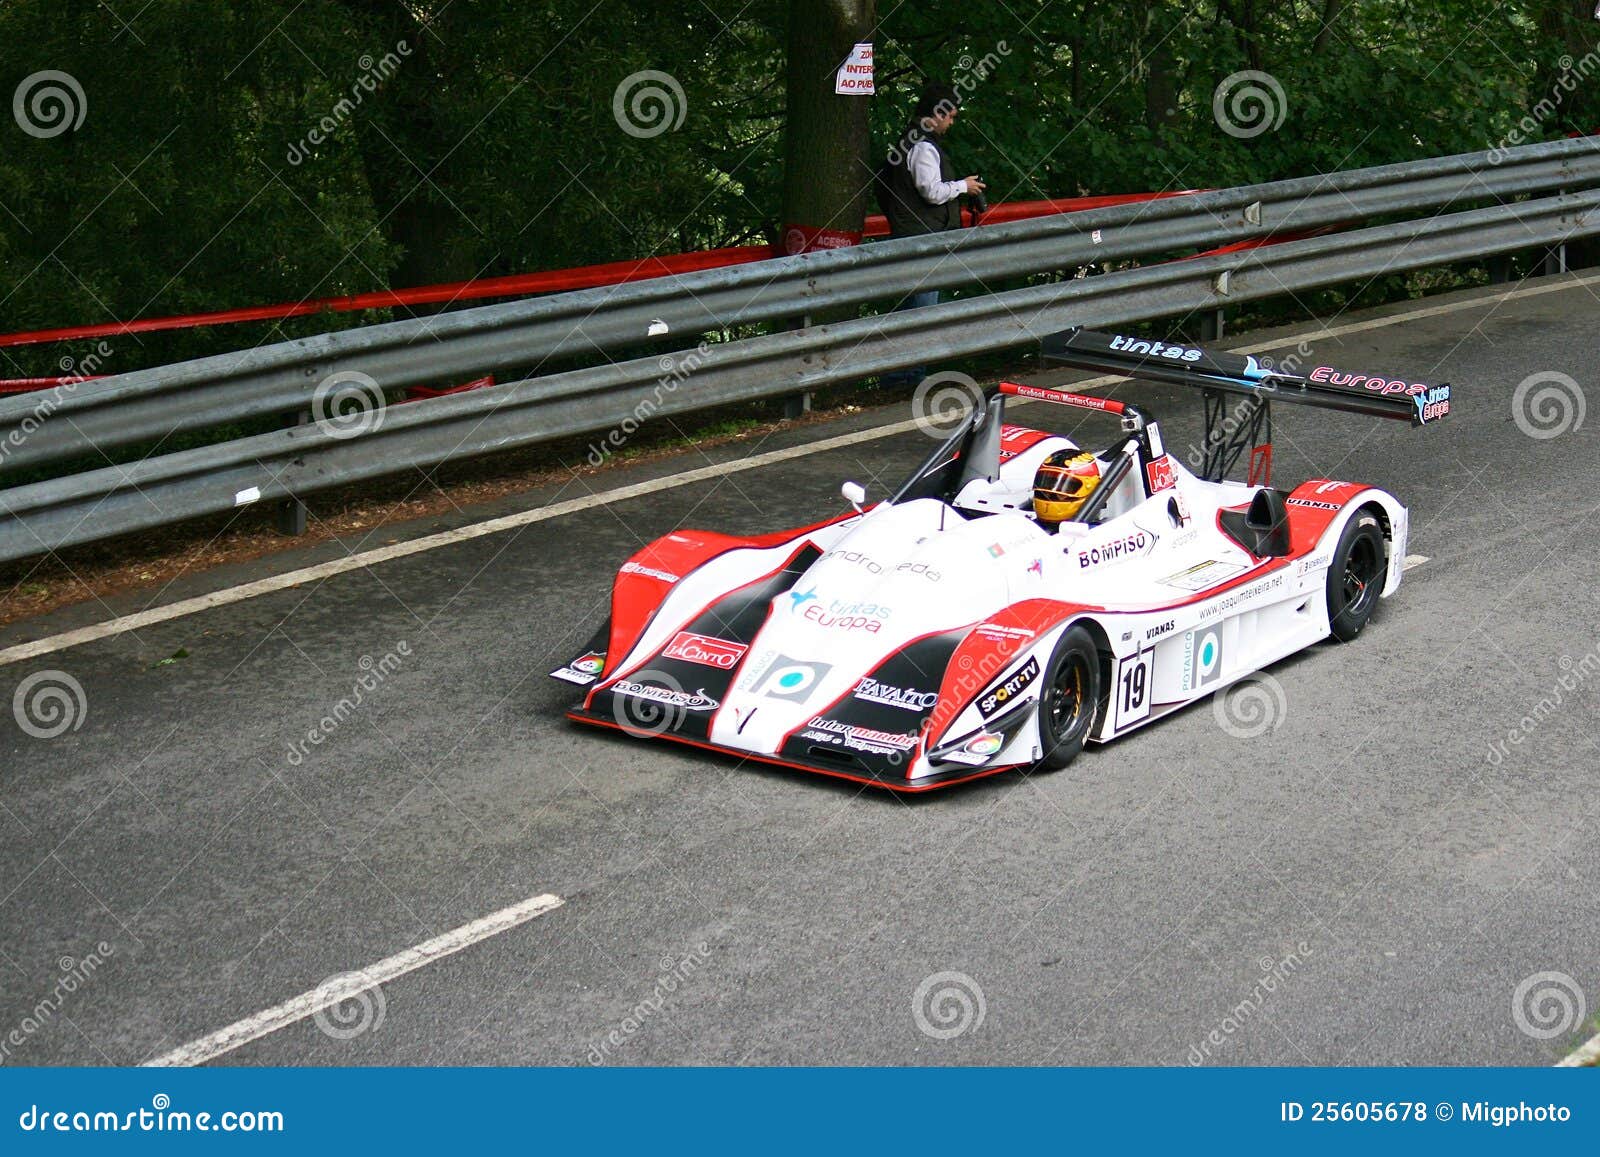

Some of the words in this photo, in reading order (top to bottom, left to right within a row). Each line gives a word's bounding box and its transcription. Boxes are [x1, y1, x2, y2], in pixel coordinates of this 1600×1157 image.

[1109, 335, 1202, 362] tintas
[1309, 366, 1428, 396] Europa
[1287, 498, 1341, 511] VIANAS
[1078, 532, 1146, 569] BOMPISO
[819, 550, 941, 583] androeda
[803, 604, 882, 634] Europa
[829, 599, 892, 620] tintas
[1146, 620, 1175, 640] VIANAS
[667, 645, 736, 667] JACINTO
[1182, 631, 1193, 692] POTAUCO
[611, 680, 704, 706] BOMPISO
[1122, 661, 1147, 713] 19
